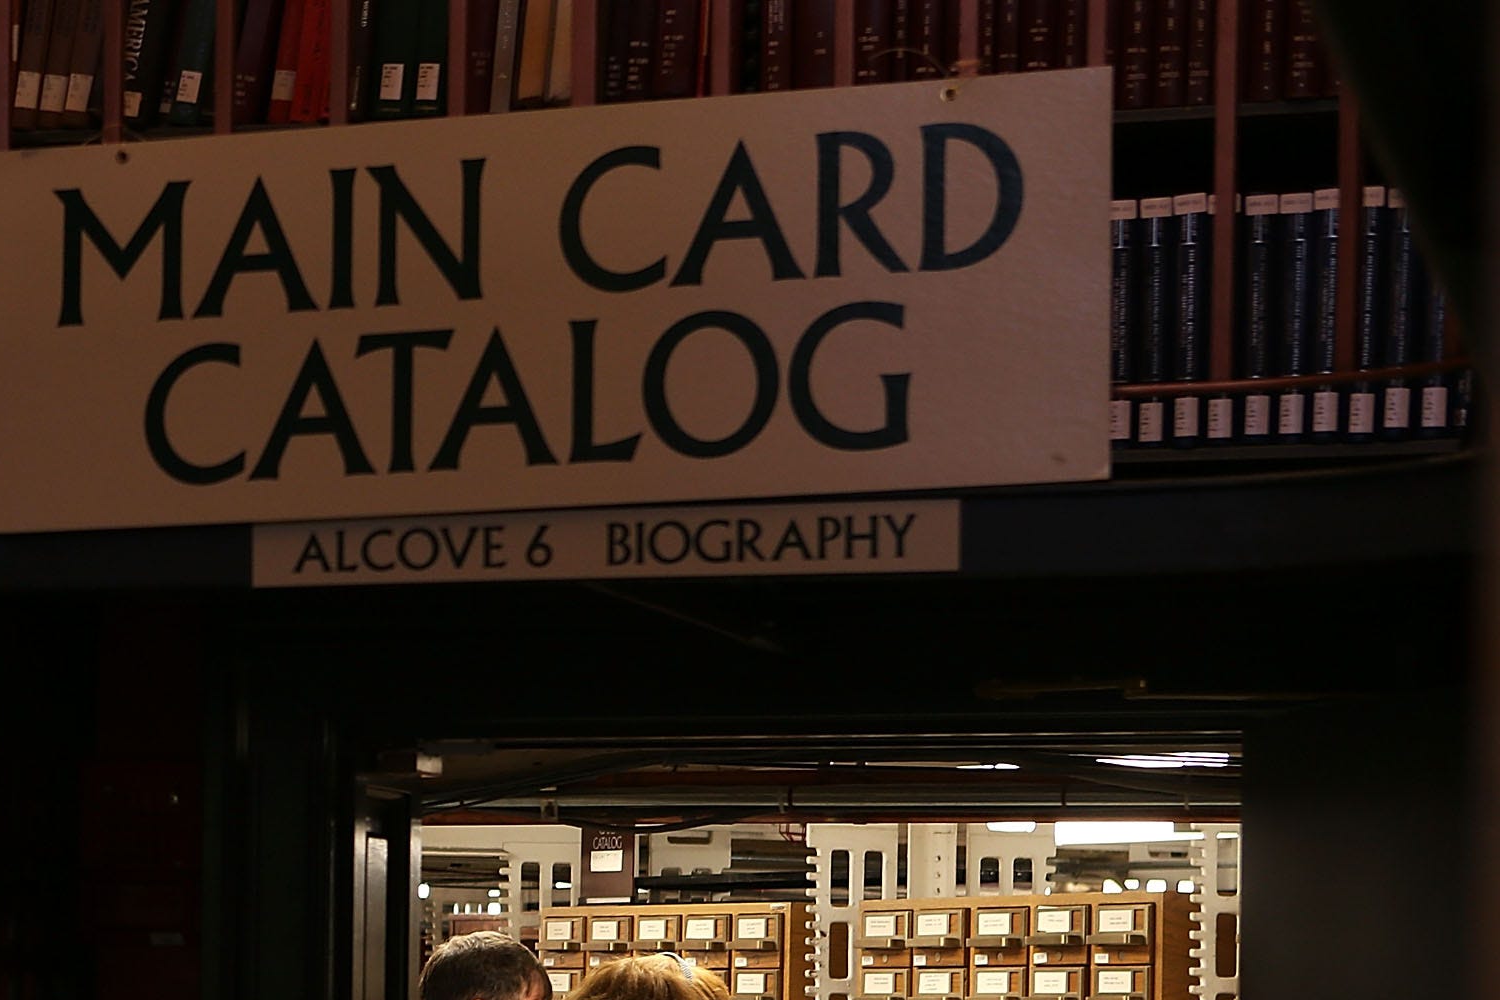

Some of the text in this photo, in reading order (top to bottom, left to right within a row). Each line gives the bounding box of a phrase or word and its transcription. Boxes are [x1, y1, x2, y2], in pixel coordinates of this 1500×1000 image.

[53, 122, 1024, 328] MAIN CARD
[144, 301, 911, 485] CATALOG
[293, 513, 917, 576] ALCOVE 6 BIOGRAPHY
[593, 836, 623, 849] CATALOG
